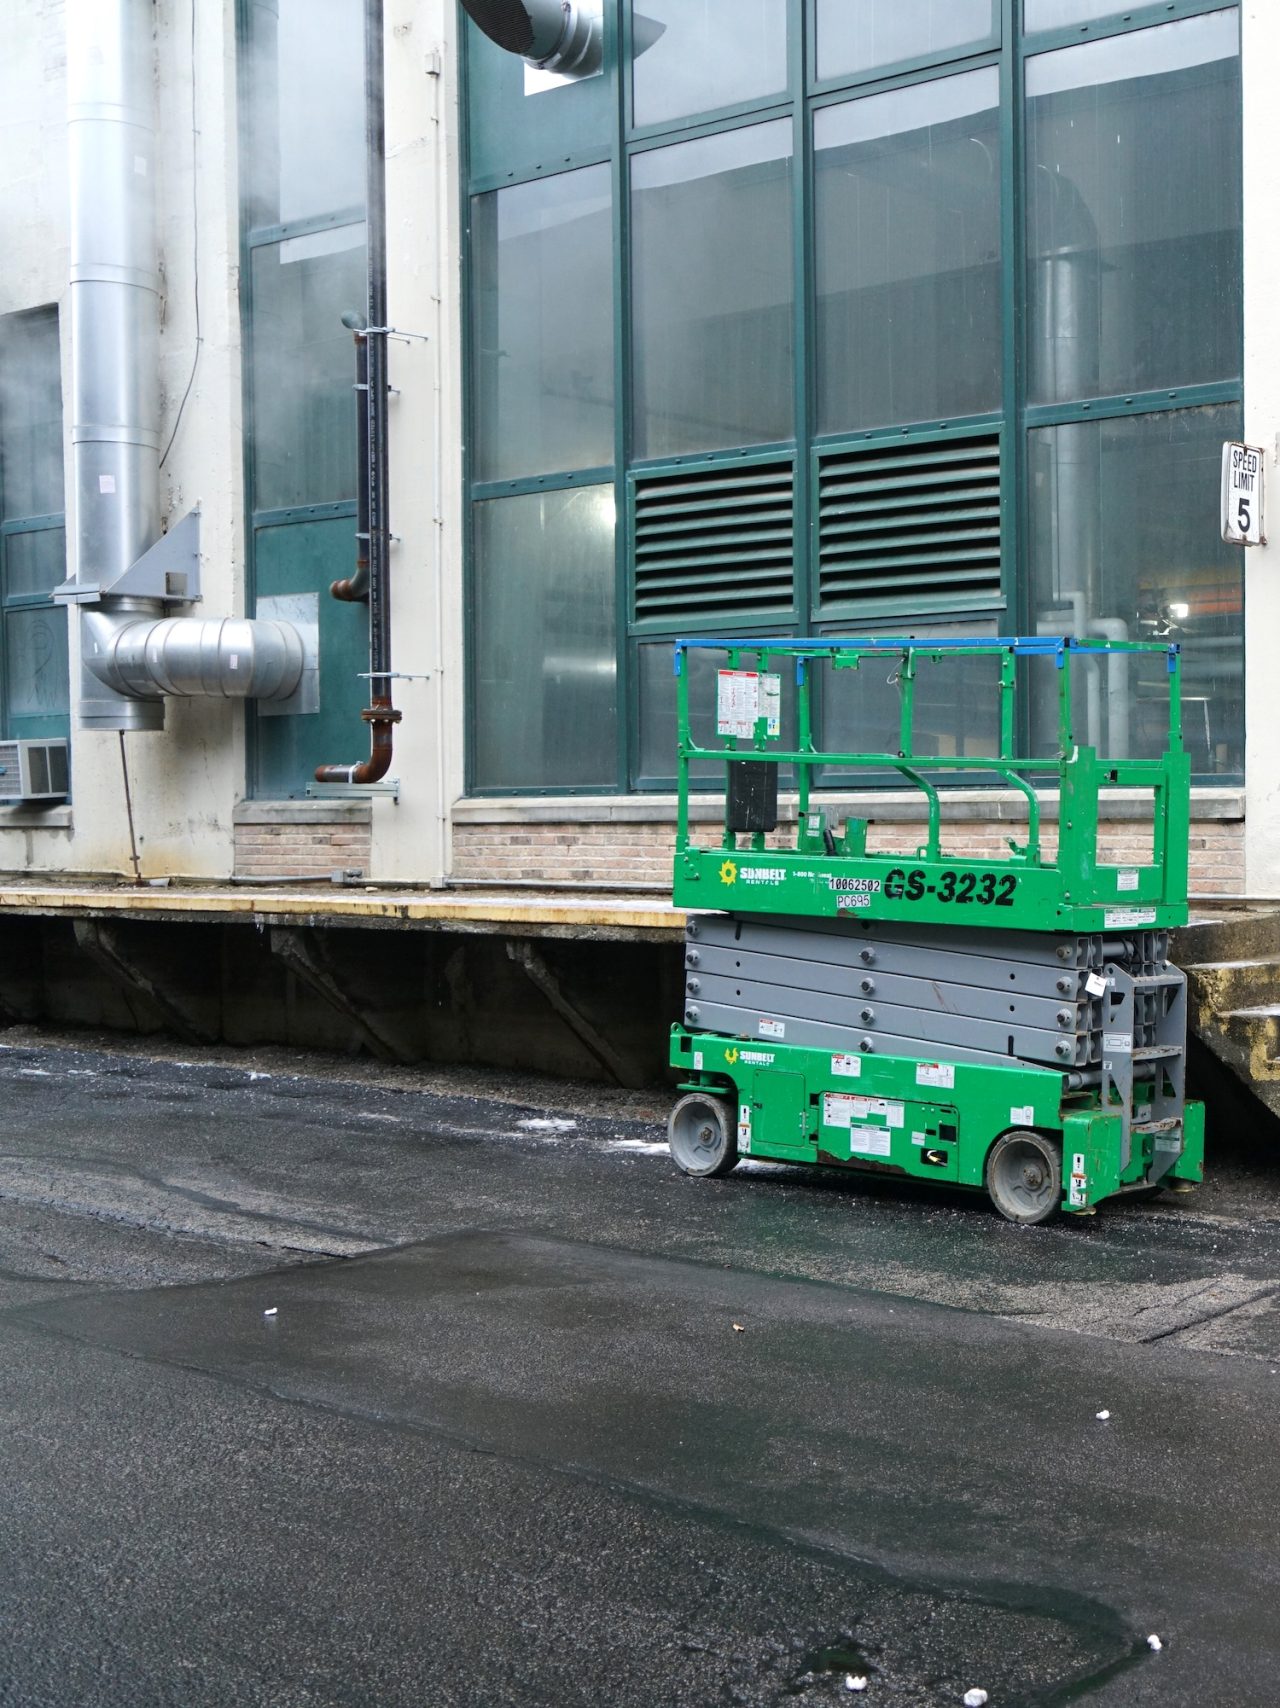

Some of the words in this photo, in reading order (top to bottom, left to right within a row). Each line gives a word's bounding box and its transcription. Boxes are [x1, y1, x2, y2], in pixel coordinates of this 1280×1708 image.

[1233, 450, 1257, 473] SPEED
[1233, 470, 1255, 492] LIMIT
[1237, 497, 1251, 533] 5
[740, 867, 786, 881] SUNBELT
[830, 878, 880, 892] 10062502
[884, 868, 1017, 906] GS-3232
[837, 894, 870, 907] PC695
[740, 1051, 775, 1063] SUNBELT
